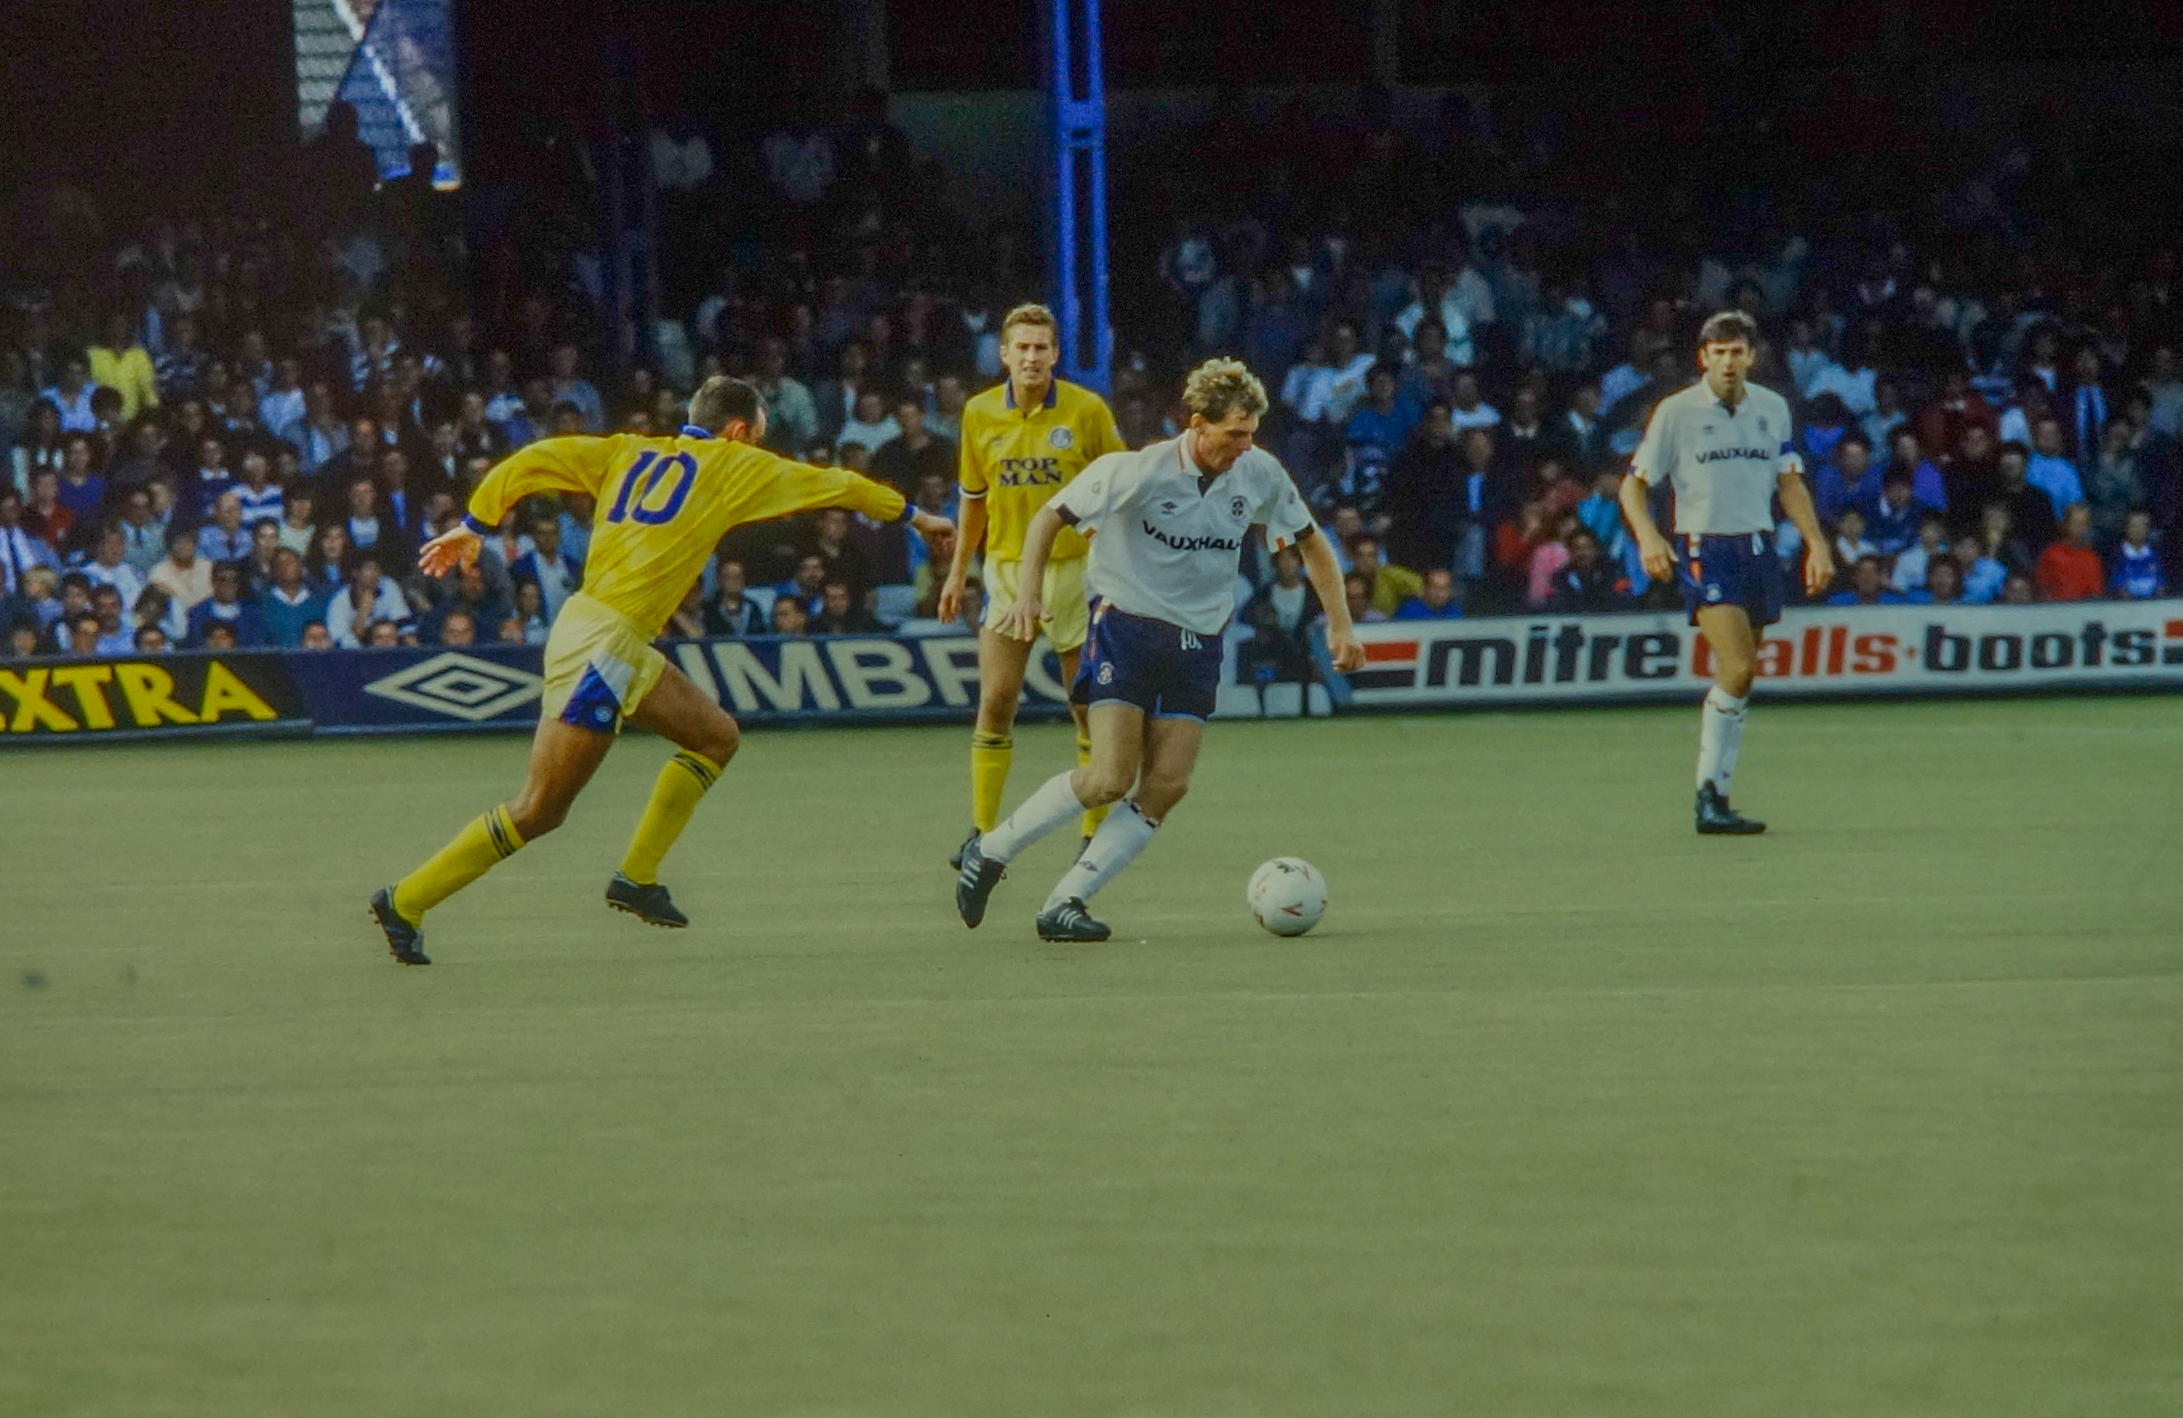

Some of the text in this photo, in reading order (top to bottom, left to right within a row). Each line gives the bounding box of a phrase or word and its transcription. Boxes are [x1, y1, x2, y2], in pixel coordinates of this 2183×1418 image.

[1000, 457, 1058, 472] TOP
[1695, 446, 1771, 464] VAUXAL
[606, 450, 698, 525] 10
[999, 471, 1063, 487] MAN
[1142, 519, 1243, 552] VAUXHAL
[1426, 625, 1680, 688] mitre
[1924, 621, 2156, 672] boots
[0, 660, 278, 733] XTRA
